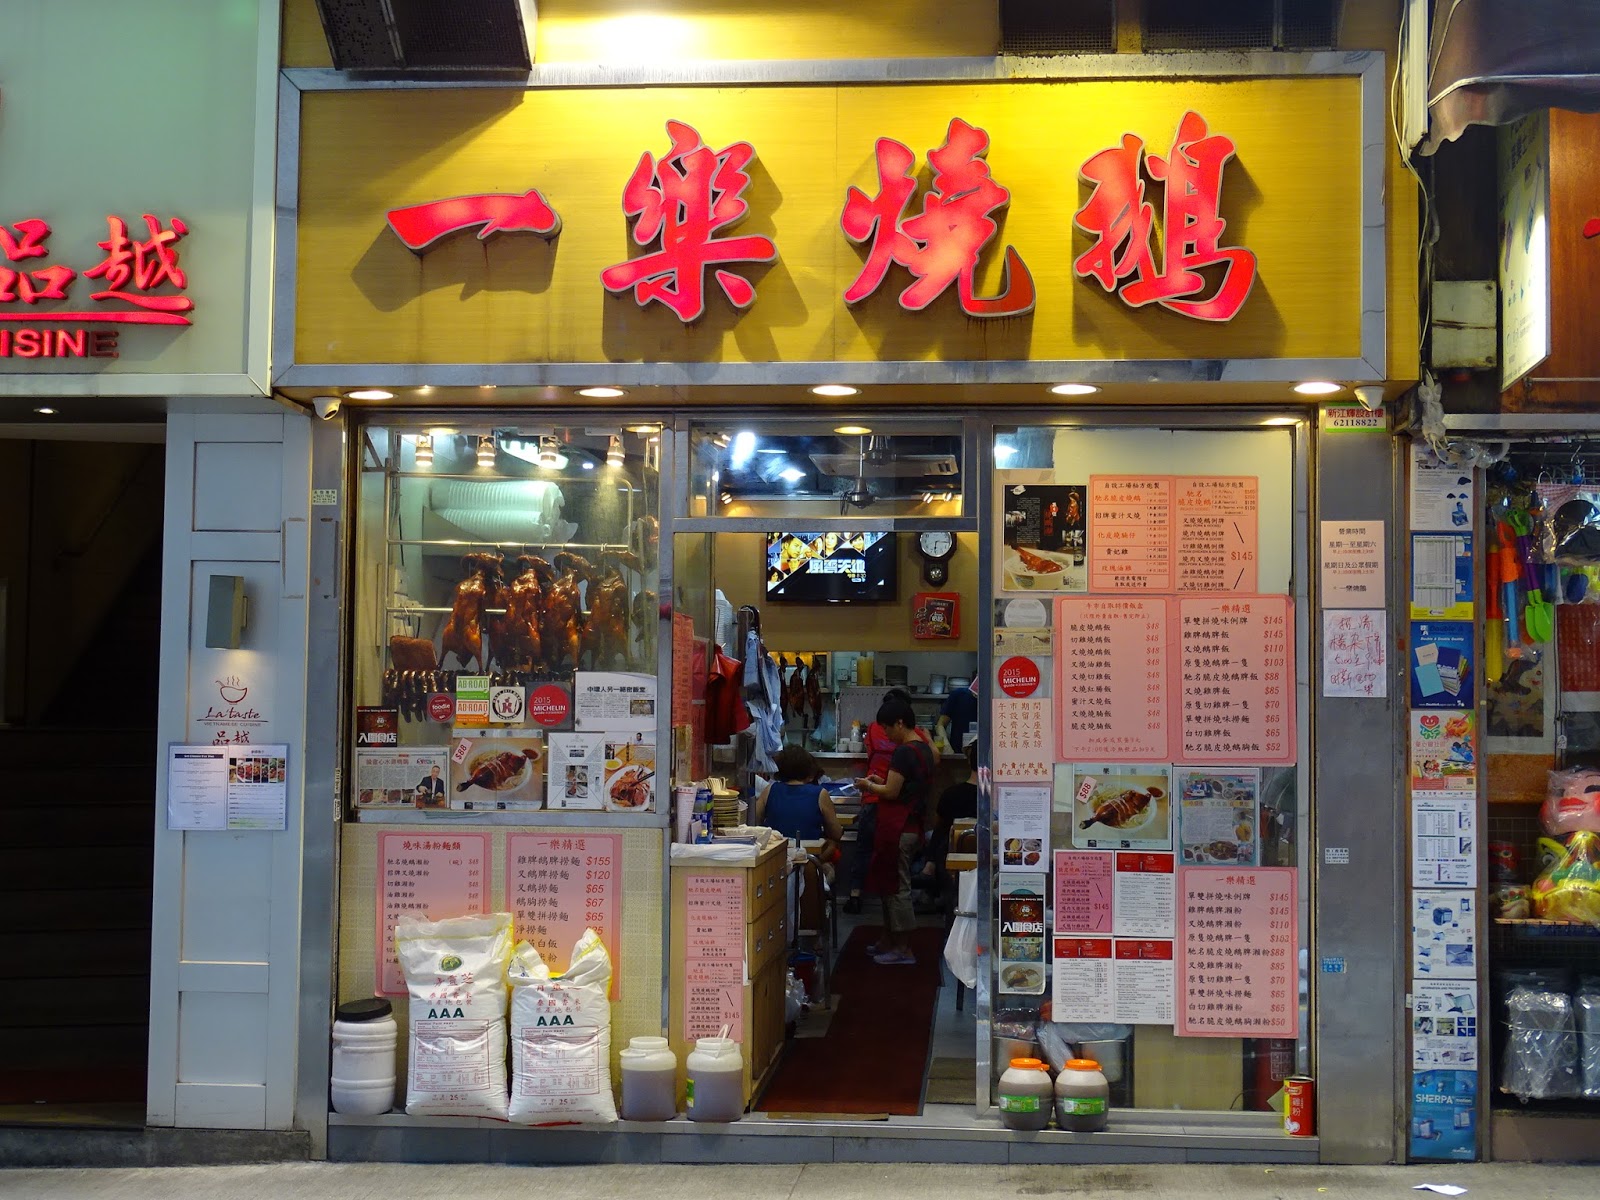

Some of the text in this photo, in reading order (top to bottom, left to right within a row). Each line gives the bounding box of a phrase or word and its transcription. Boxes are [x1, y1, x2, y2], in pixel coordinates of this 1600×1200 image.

[386, 111, 1257, 323] 一樂燒鵝
[1231, 552, 1253, 560] $145
[1211, 604, 1251, 614] 一樂精選
[1263, 617, 1283, 625] $145
[1263, 630, 1283, 639] $145
[1264, 645, 1284, 653] $110
[1264, 658, 1284, 667] $103
[1264, 673, 1279, 681] $88
[1072, 685, 1111, 693] 叉燒紅腸飯
[1264, 687, 1279, 695] $85
[1265, 701, 1280, 709] $70
[1072, 710, 1112, 718] 叉燒燒腩飯
[1265, 715, 1280, 723] $65
[999, 731, 1042, 739] 不便之處
[1265, 729, 1280, 737] $65
[999, 740, 1042, 748] 敬請原諒
[1265, 743, 1281, 751] $52
[454, 744, 467, 760] $88
[1079, 782, 1092, 799] $88
[403, 841, 461, 850] 燒味湯粉麵類
[537, 840, 586, 850] 一樂精選
[586, 857, 610, 865] $155
[586, 871, 610, 879] $120
[1216, 876, 1256, 886] 一樂精選
[586, 884, 604, 893] $65
[1270, 893, 1289, 901] $145
[586, 899, 604, 907] $67
[1270, 907, 1289, 915] $145
[585, 912, 603, 921] $65
[1270, 921, 1289, 929] $110
[1270, 949, 1285, 957] $88
[1270, 962, 1285, 970] $85
[1270, 976, 1285, 985] $70
[1270, 990, 1285, 998] $65
[1270, 1004, 1285, 1012] $65
[1270, 1018, 1285, 1026] $50
[1416, 1094, 1453, 1104] SHERPA
